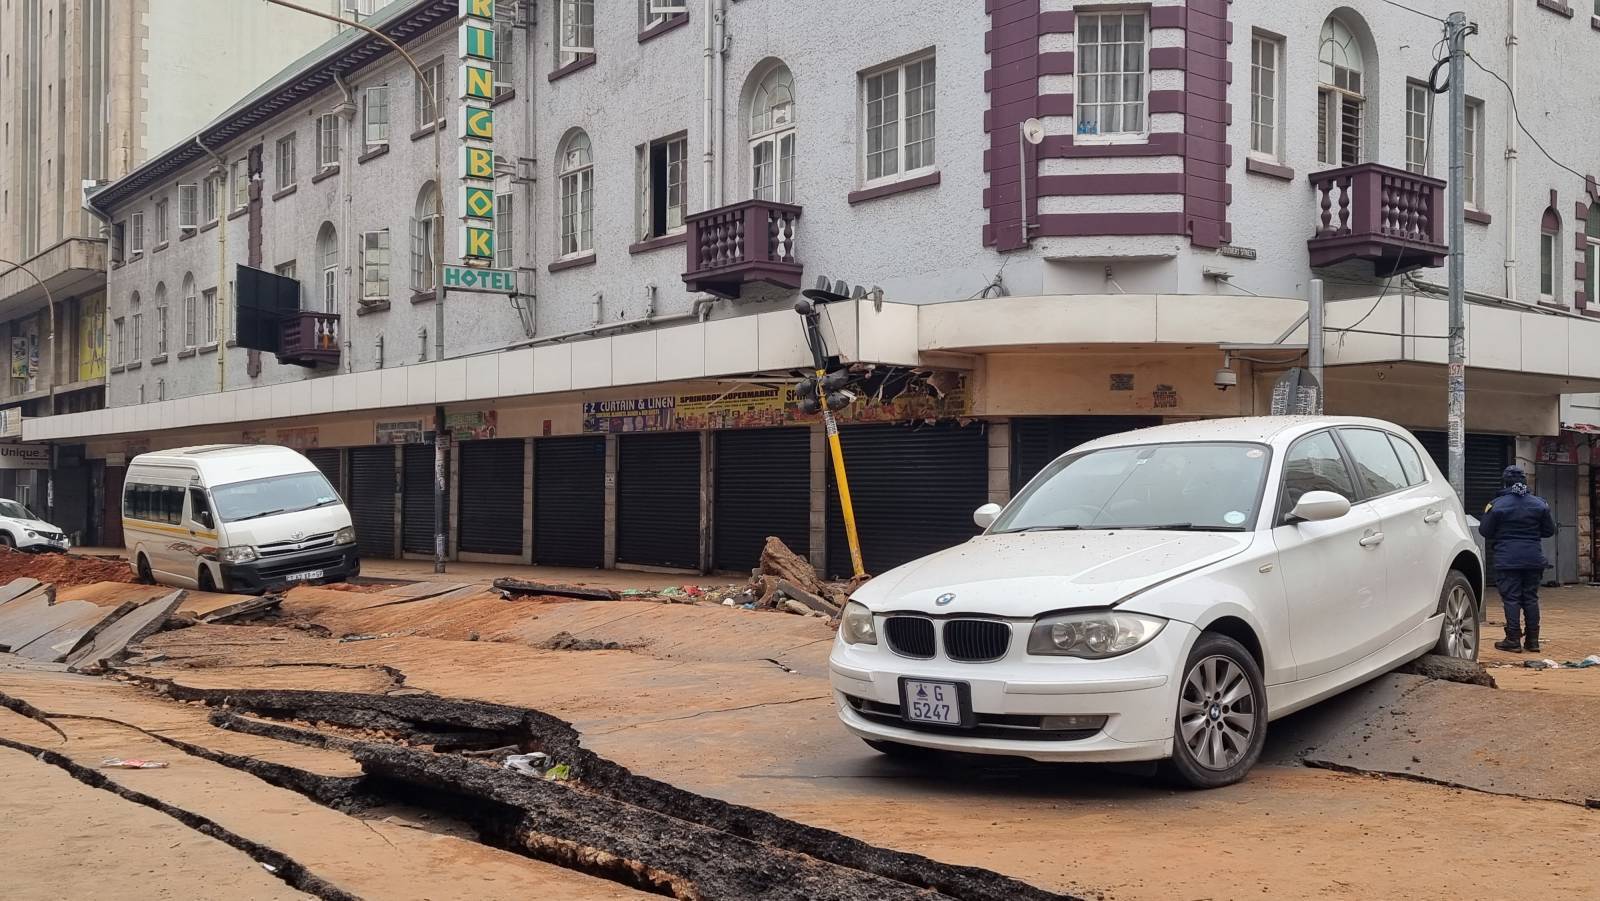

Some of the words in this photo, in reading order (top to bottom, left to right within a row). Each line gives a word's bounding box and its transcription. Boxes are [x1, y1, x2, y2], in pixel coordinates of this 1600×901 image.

[445, 268, 514, 290] HOTEL
[600, 400, 635, 412] CURTAIN
[638, 399, 645, 410] &
[648, 396, 674, 409] LINEN
[1, 448, 40, 458] Unique
[934, 685, 944, 701] G
[913, 702, 951, 720] 5247
